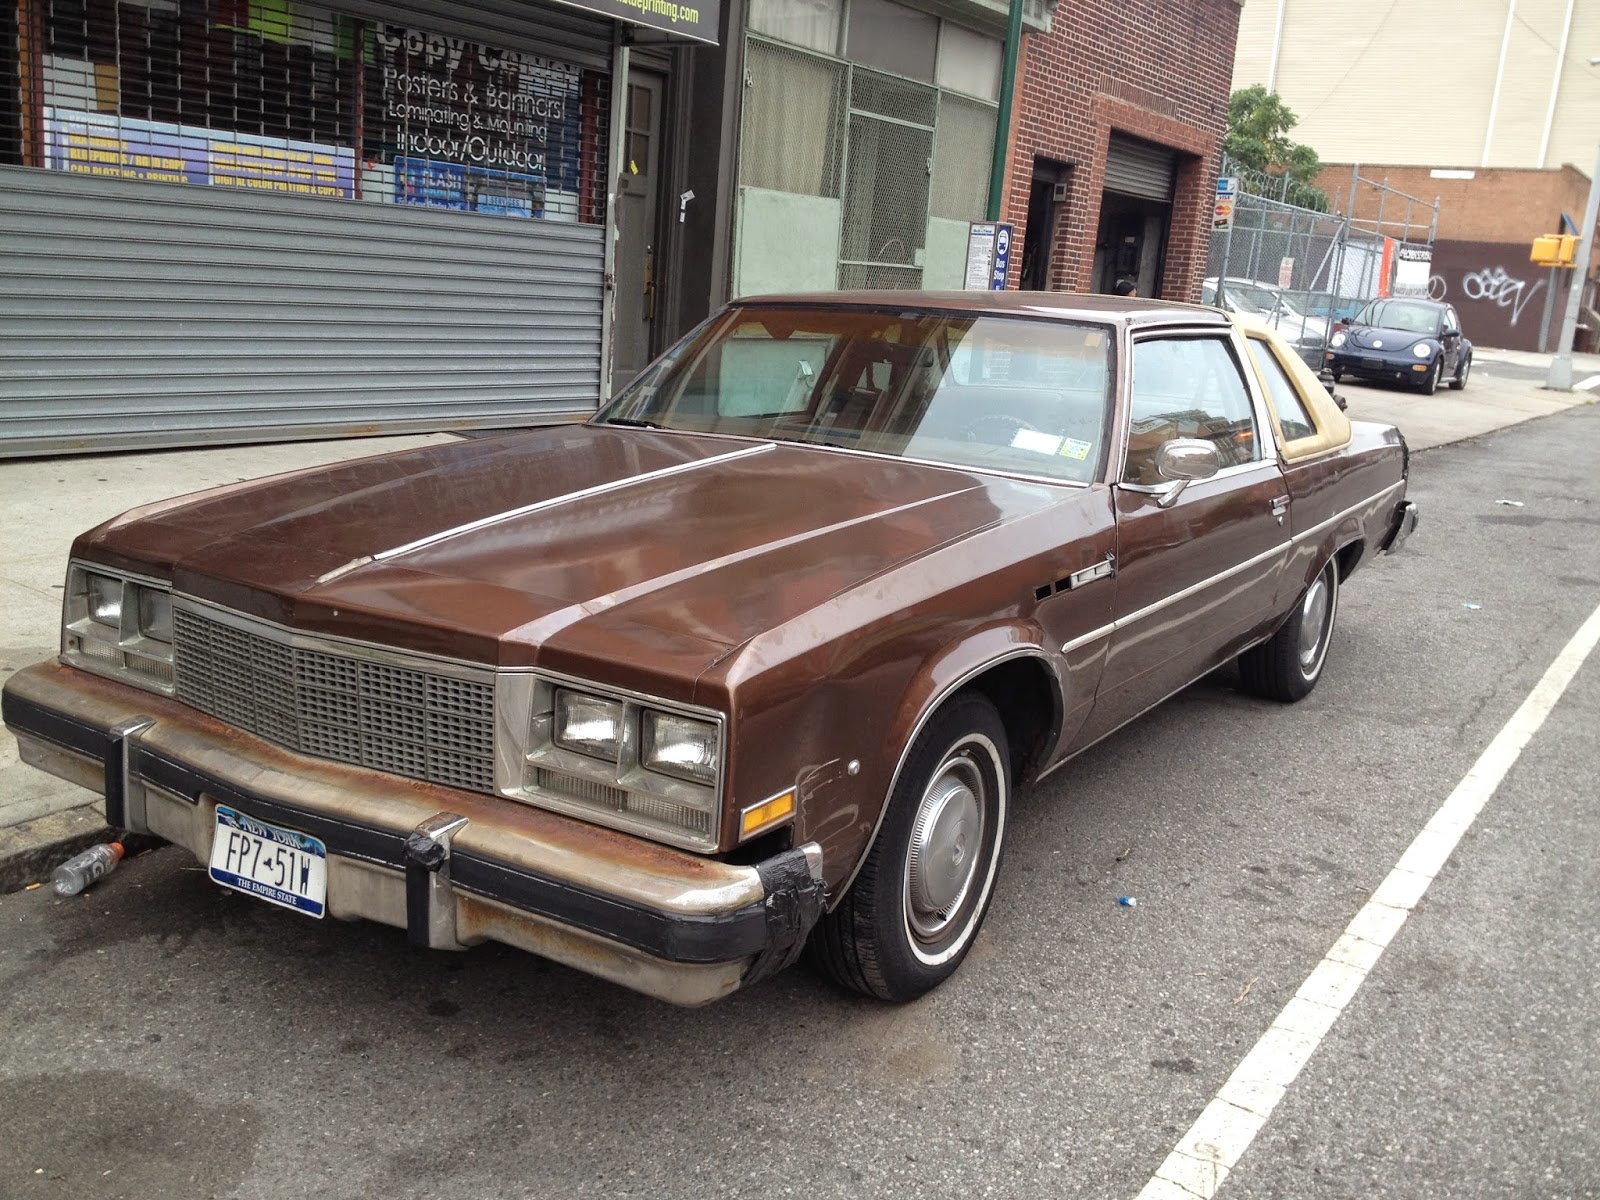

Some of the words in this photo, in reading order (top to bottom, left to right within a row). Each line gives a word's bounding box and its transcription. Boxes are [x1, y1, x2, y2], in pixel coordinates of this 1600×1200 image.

[616, 0, 699, 24] ueprinting.com
[376, 21, 465, 74] Copy
[384, 67, 459, 101] Posters
[389, 100, 470, 132] Laminating
[487, 115, 548, 143] Mounting
[92, 166, 137, 179] PLOTTNG
[317, 185, 344, 197] COPIS
[995, 258, 1006, 269] Bus
[993, 270, 1005, 282] Stop
[237, 877, 251, 889] THE
[252, 881, 277, 899] EMPIRE
[277, 891, 298, 906] STATE
